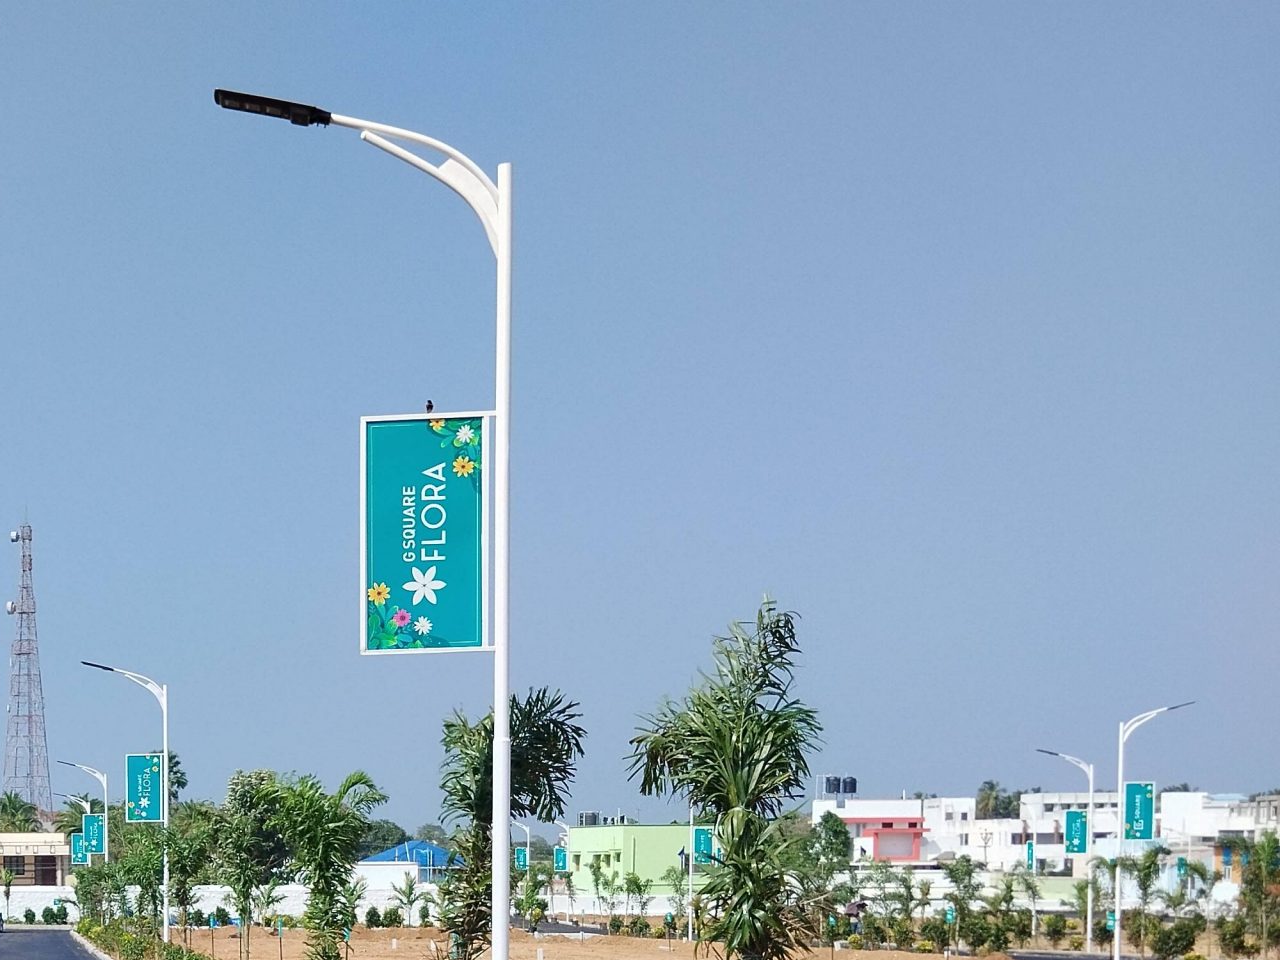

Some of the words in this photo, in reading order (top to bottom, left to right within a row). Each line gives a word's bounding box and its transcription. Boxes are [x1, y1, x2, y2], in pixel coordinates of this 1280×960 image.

[402, 485, 416, 549] SQUARE
[421, 462, 447, 561] FLORA
[402, 552, 415, 563] G
[143, 767, 151, 797] FLORA
